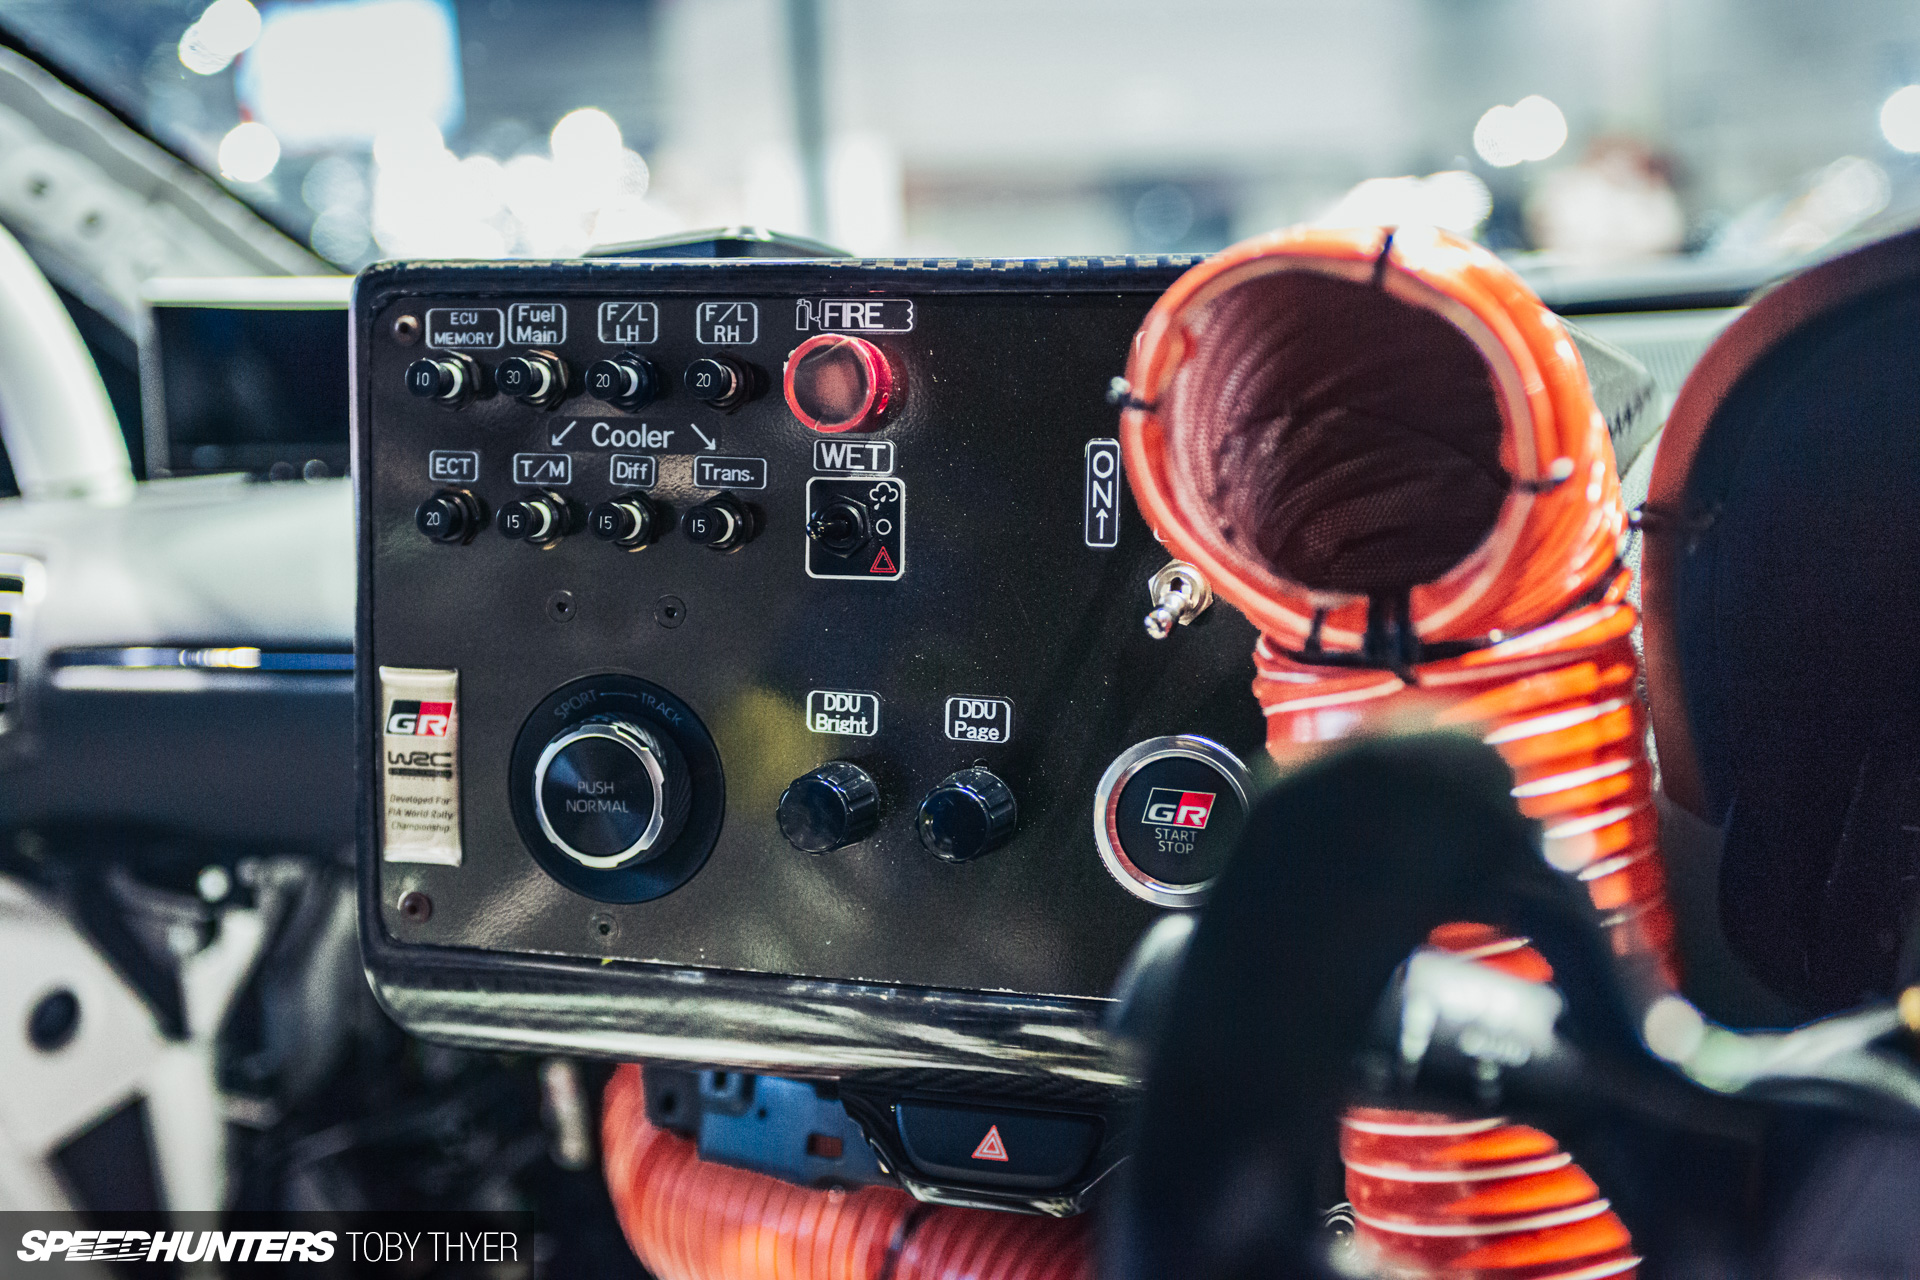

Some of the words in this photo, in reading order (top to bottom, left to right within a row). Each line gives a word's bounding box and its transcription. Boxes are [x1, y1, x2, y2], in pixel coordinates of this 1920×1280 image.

[450, 312, 478, 325] ECU
[518, 305, 556, 322] Fuel
[607, 303, 648, 322] F/L
[705, 303, 748, 322] F/L
[824, 302, 884, 328] FIRE
[434, 332, 494, 345] MEMORY
[517, 326, 557, 342] Main
[615, 325, 639, 341] LH
[714, 325, 740, 341] RH
[416, 372, 430, 386] 10
[506, 370, 520, 384] 30
[596, 373, 610, 387] 20
[696, 373, 711, 387] 20
[591, 422, 675, 448] Cooler
[820, 442, 886, 470] WET
[435, 457, 471, 475] ECT
[520, 460, 565, 478] T/M
[616, 461, 648, 480] Diff
[701, 463, 755, 481] Trans.
[1092, 450, 1114, 509] ON
[426, 511, 440, 526] 20
[507, 514, 520, 528] 15
[599, 515, 613, 530] 15
[692, 519, 706, 533] 15
[554, 689, 597, 719] SPORT
[641, 692, 682, 726] TRACK
[823, 693, 861, 713] DDU
[959, 700, 997, 720] DDU
[388, 713, 448, 736] GR
[815, 712, 868, 734] Bright
[955, 720, 1000, 741] Page
[388, 751, 452, 767] WRC
[577, 781, 615, 795] PUSH
[390, 793, 433, 805] Developed
[565, 799, 629, 813] NORMAL
[1148, 803, 1207, 825] GR
[1155, 827, 1198, 843] START
[1158, 840, 1194, 854] STOP
